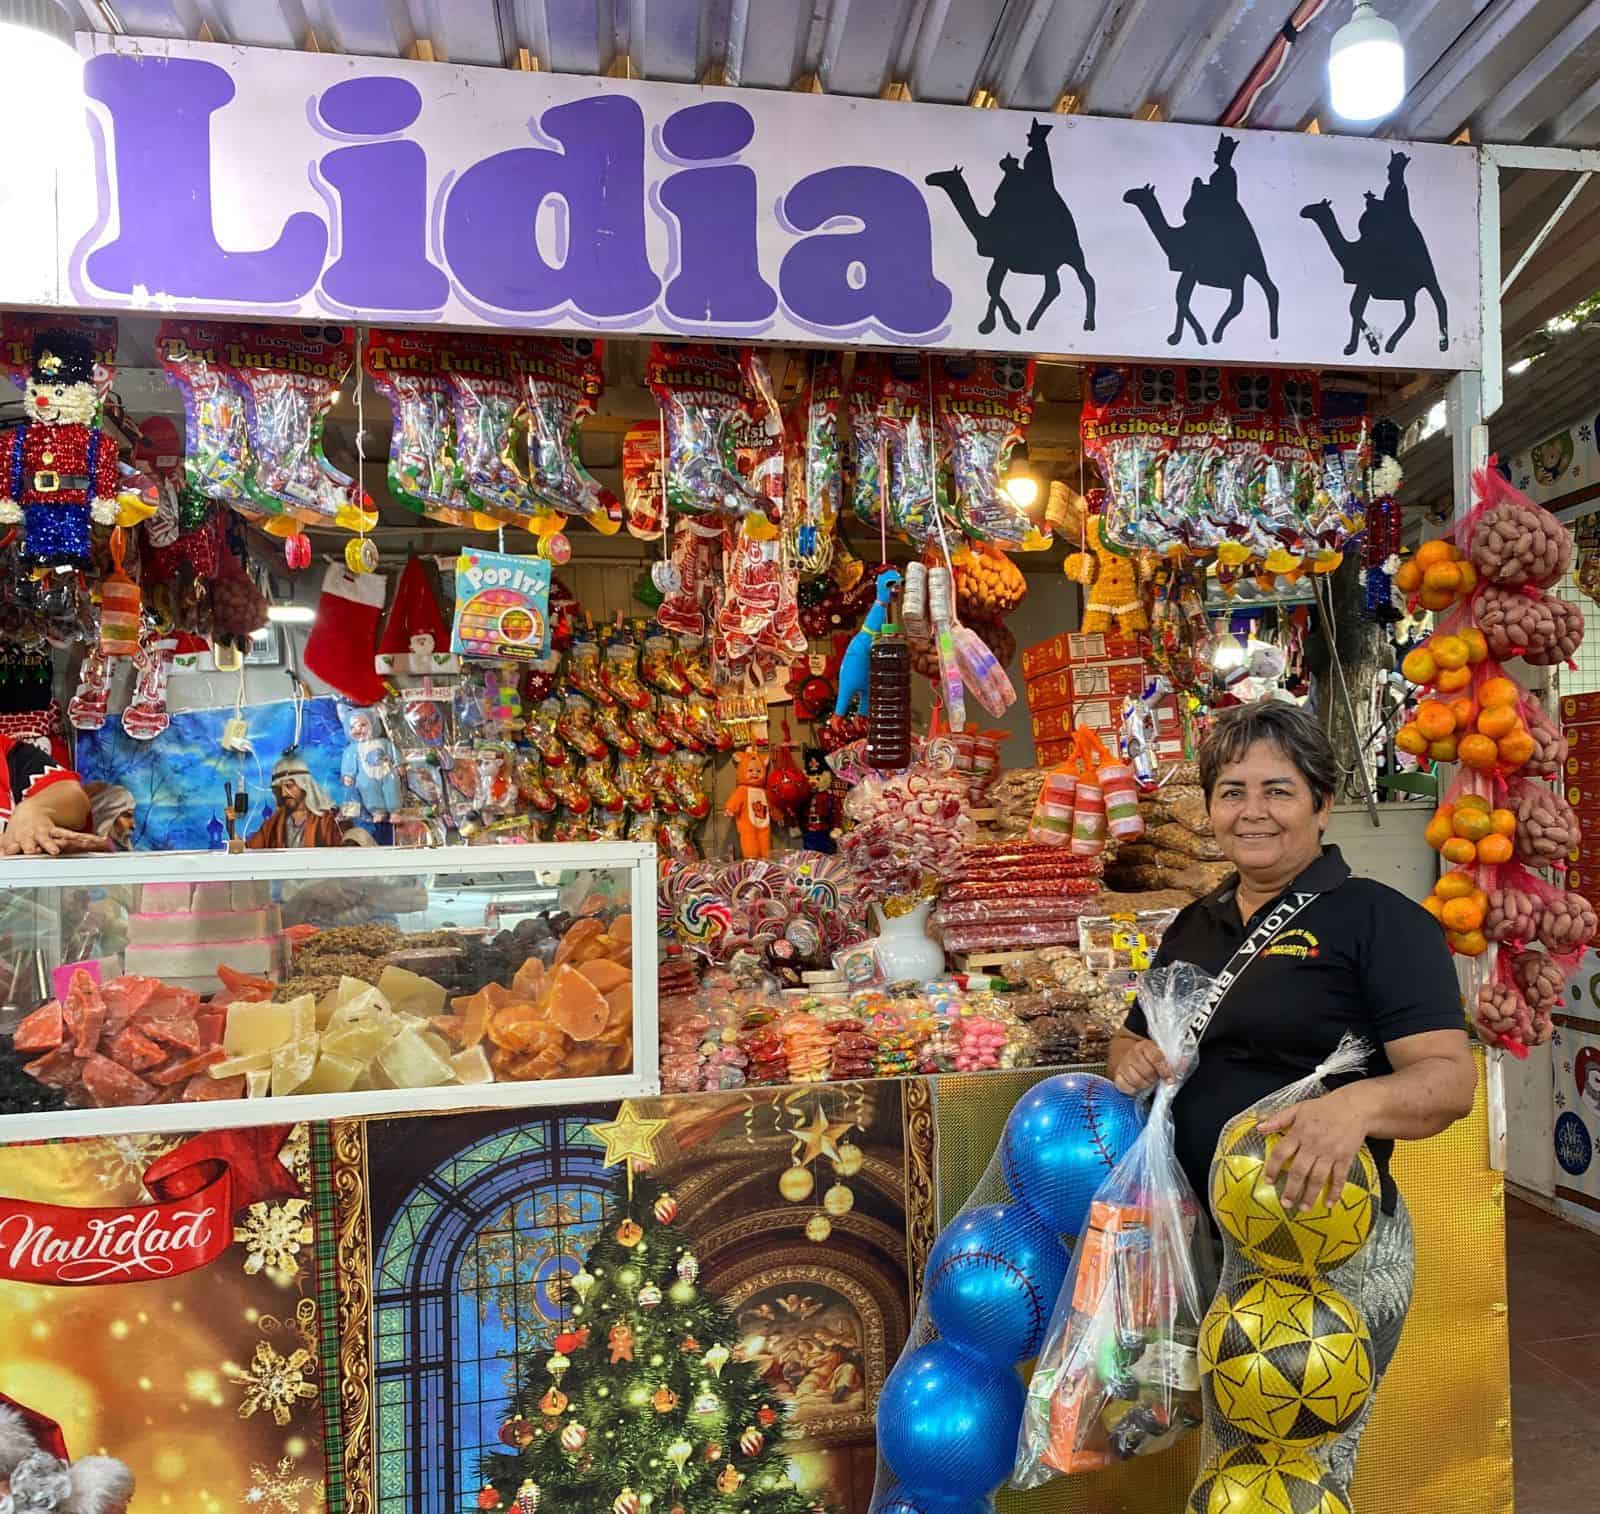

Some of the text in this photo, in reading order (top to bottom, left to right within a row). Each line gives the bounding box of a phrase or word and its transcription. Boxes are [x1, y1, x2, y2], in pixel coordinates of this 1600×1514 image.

[80, 53, 953, 340] Lidia
[465, 566, 545, 596] POP IT!
[0, 1207, 215, 1281] Navidad
